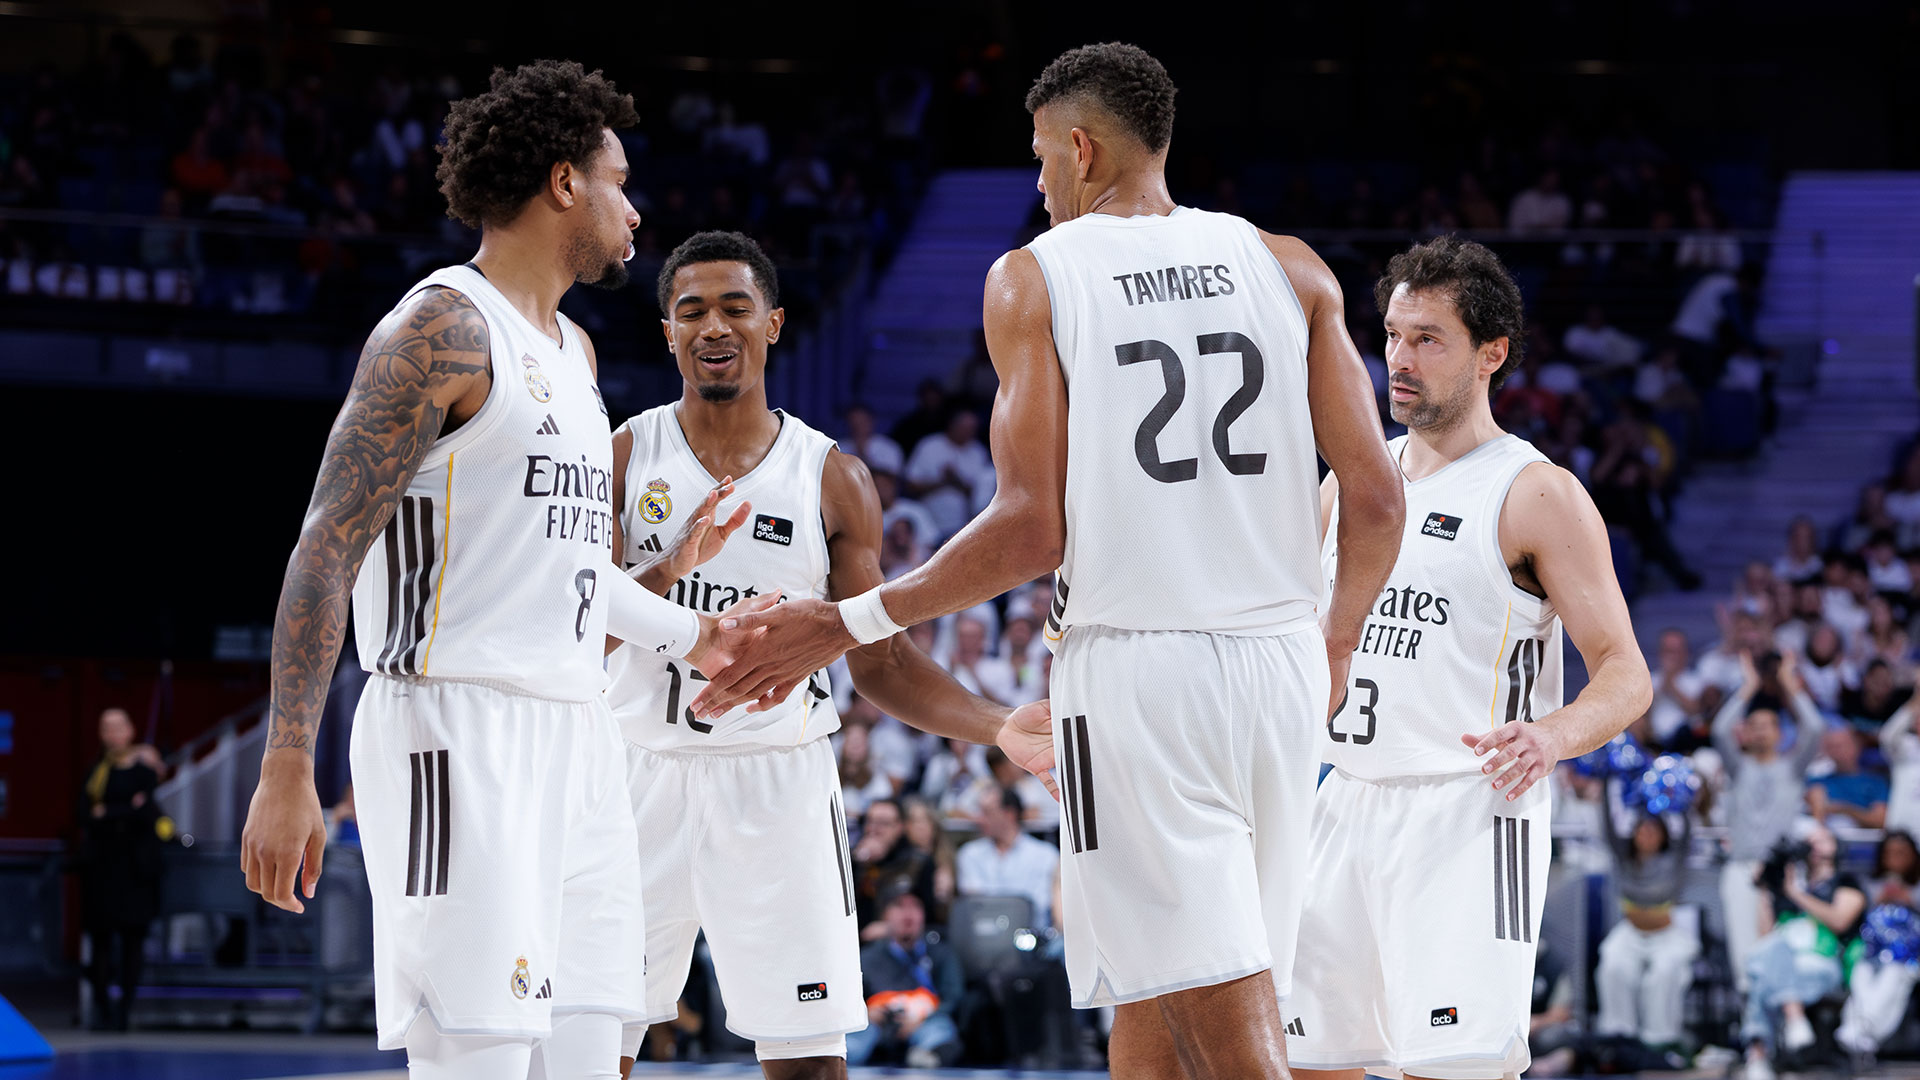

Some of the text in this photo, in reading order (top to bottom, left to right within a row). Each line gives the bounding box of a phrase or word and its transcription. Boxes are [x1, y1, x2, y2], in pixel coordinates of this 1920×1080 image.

[1113, 264, 1236, 306] TAVARES
[1114, 331, 1268, 484] 22
[546, 505, 581, 540] FLY
[757, 520, 774, 532] liga
[1426, 518, 1442, 529] liga
[756, 530, 790, 544] endesa
[1424, 526, 1456, 538] endesa
[575, 568, 597, 643] 8
[1353, 623, 1423, 660] ETTER
[800, 989, 822, 1000] acb
[1432, 1014, 1452, 1025] acb
